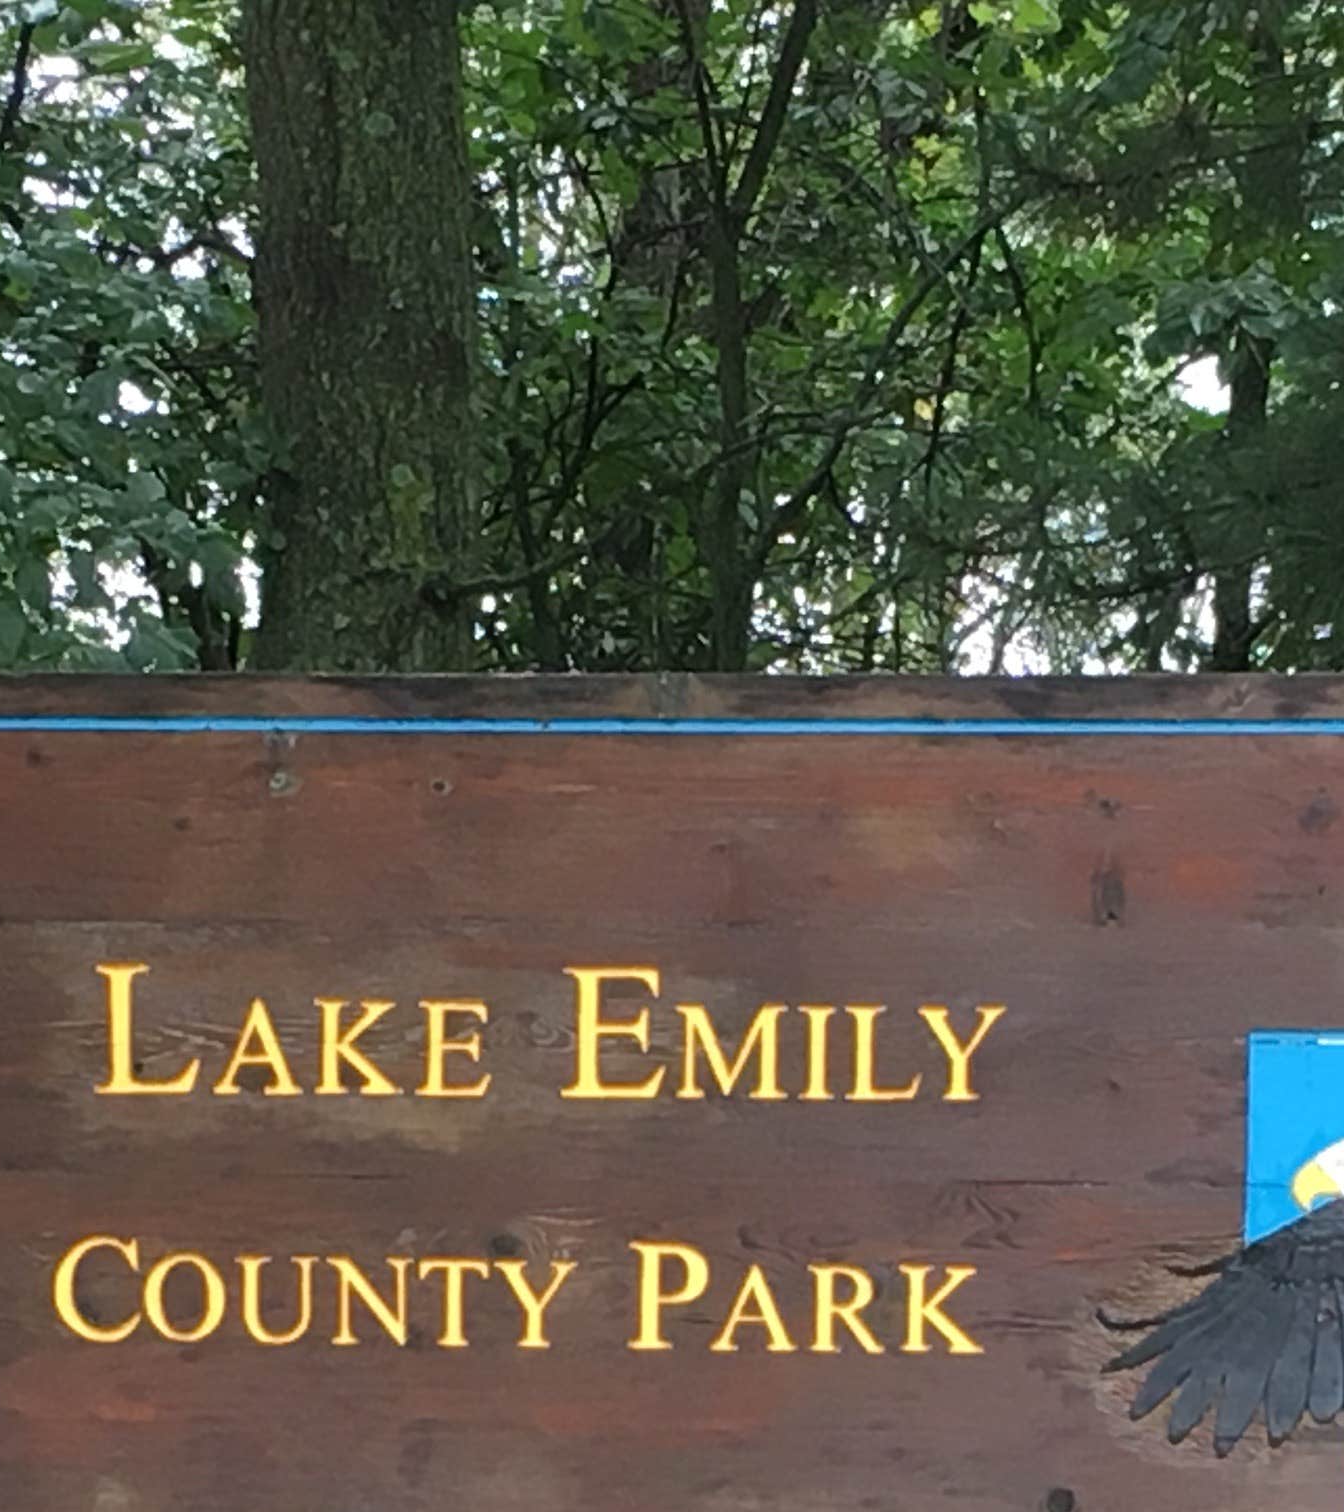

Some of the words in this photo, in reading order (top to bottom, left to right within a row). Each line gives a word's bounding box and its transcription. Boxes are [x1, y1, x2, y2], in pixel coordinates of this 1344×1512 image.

[92, 961, 494, 1099] LAKE
[559, 966, 1007, 1102] EMILY
[52, 1236, 579, 1350] COUNTY
[627, 1240, 985, 1355] PARK
